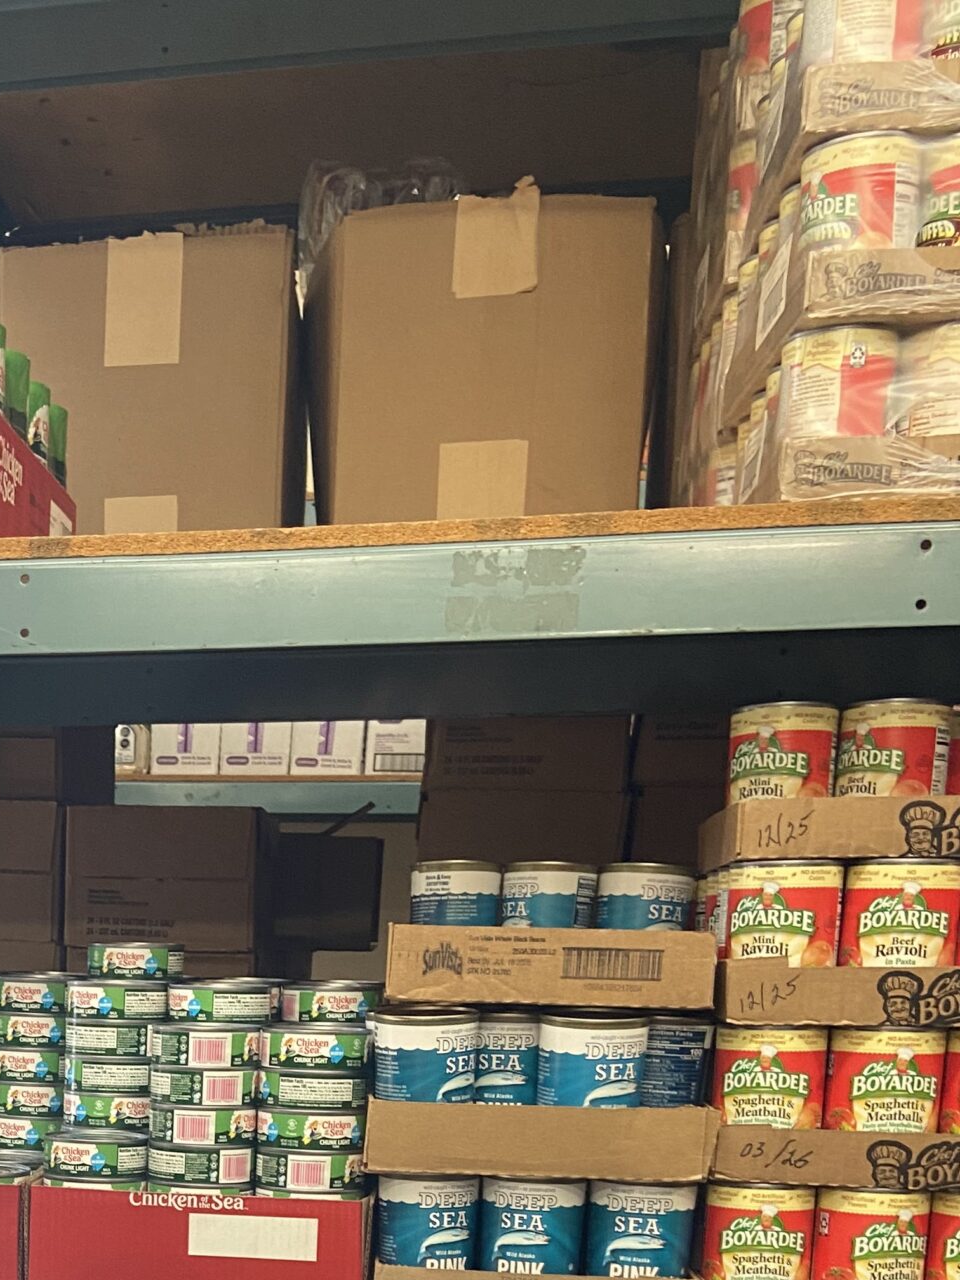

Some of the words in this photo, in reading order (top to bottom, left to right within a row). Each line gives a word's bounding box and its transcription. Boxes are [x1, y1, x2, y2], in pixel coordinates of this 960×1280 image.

[813, 462, 892, 486] BOYARDEE
[730, 751, 809, 778] BOYARDEE
[748, 777, 771, 786] Mini
[846, 775, 865, 785] Beef
[739, 783, 784, 798] Ravioli
[757, 809, 815, 848] 12/25
[647, 903, 683, 920] SEA
[736, 896, 760, 911] Chef
[869, 896, 898, 911] Chef
[730, 908, 815, 933] BOYARDEE
[859, 908, 949, 934] BOYARDEE
[752, 935, 775, 944] Mini
[891, 936, 916, 945] Beef
[116, 952, 145, 961] Chicken
[740, 943, 789, 957] Ravioli
[875, 943, 928, 958] Ravioli
[296, 1038, 329, 1048] Chicken
[475, 1033, 535, 1050] DEEP
[446, 1056, 475, 1074] SEA
[479, 1054, 523, 1071] SEA
[731, 1058, 757, 1073] Chef
[863, 1060, 892, 1076] Chef
[595, 1063, 636, 1080] SEA
[723, 1071, 809, 1094] BOYARDEE
[852, 1075, 938, 1098] BOYARDEE
[732, 1096, 785, 1112] Spaghetti
[786, 1099, 795, 1109] &
[864, 1099, 918, 1116] Spaghetti
[919, 1103, 926, 1112] &
[734, 1107, 791, 1121] Meatballs
[866, 1111, 923, 1124] Meatballs
[322, 1120, 352, 1131] Chicken
[61, 1147, 90, 1157] Chicken
[129, 1191, 199, 1211] Chicken
[211, 1194, 244, 1210] Sea
[494, 1191, 557, 1211] DEEP
[606, 1193, 674, 1214] DEEP
[429, 1212, 468, 1228] SEA
[501, 1214, 546, 1231] SEA
[614, 1217, 661, 1235] SEA
[730, 1218, 756, 1232] Chef
[721, 1231, 804, 1252] BOYARDEE
[425, 1256, 467, 1271] PINK
[497, 1258, 545, 1275] PINK
[732, 1253, 785, 1269] Spaghetti
[785, 1256, 793, 1266] &
[609, 1263, 659, 1279] PINK
[734, 1265, 790, 1278] Meatballs
